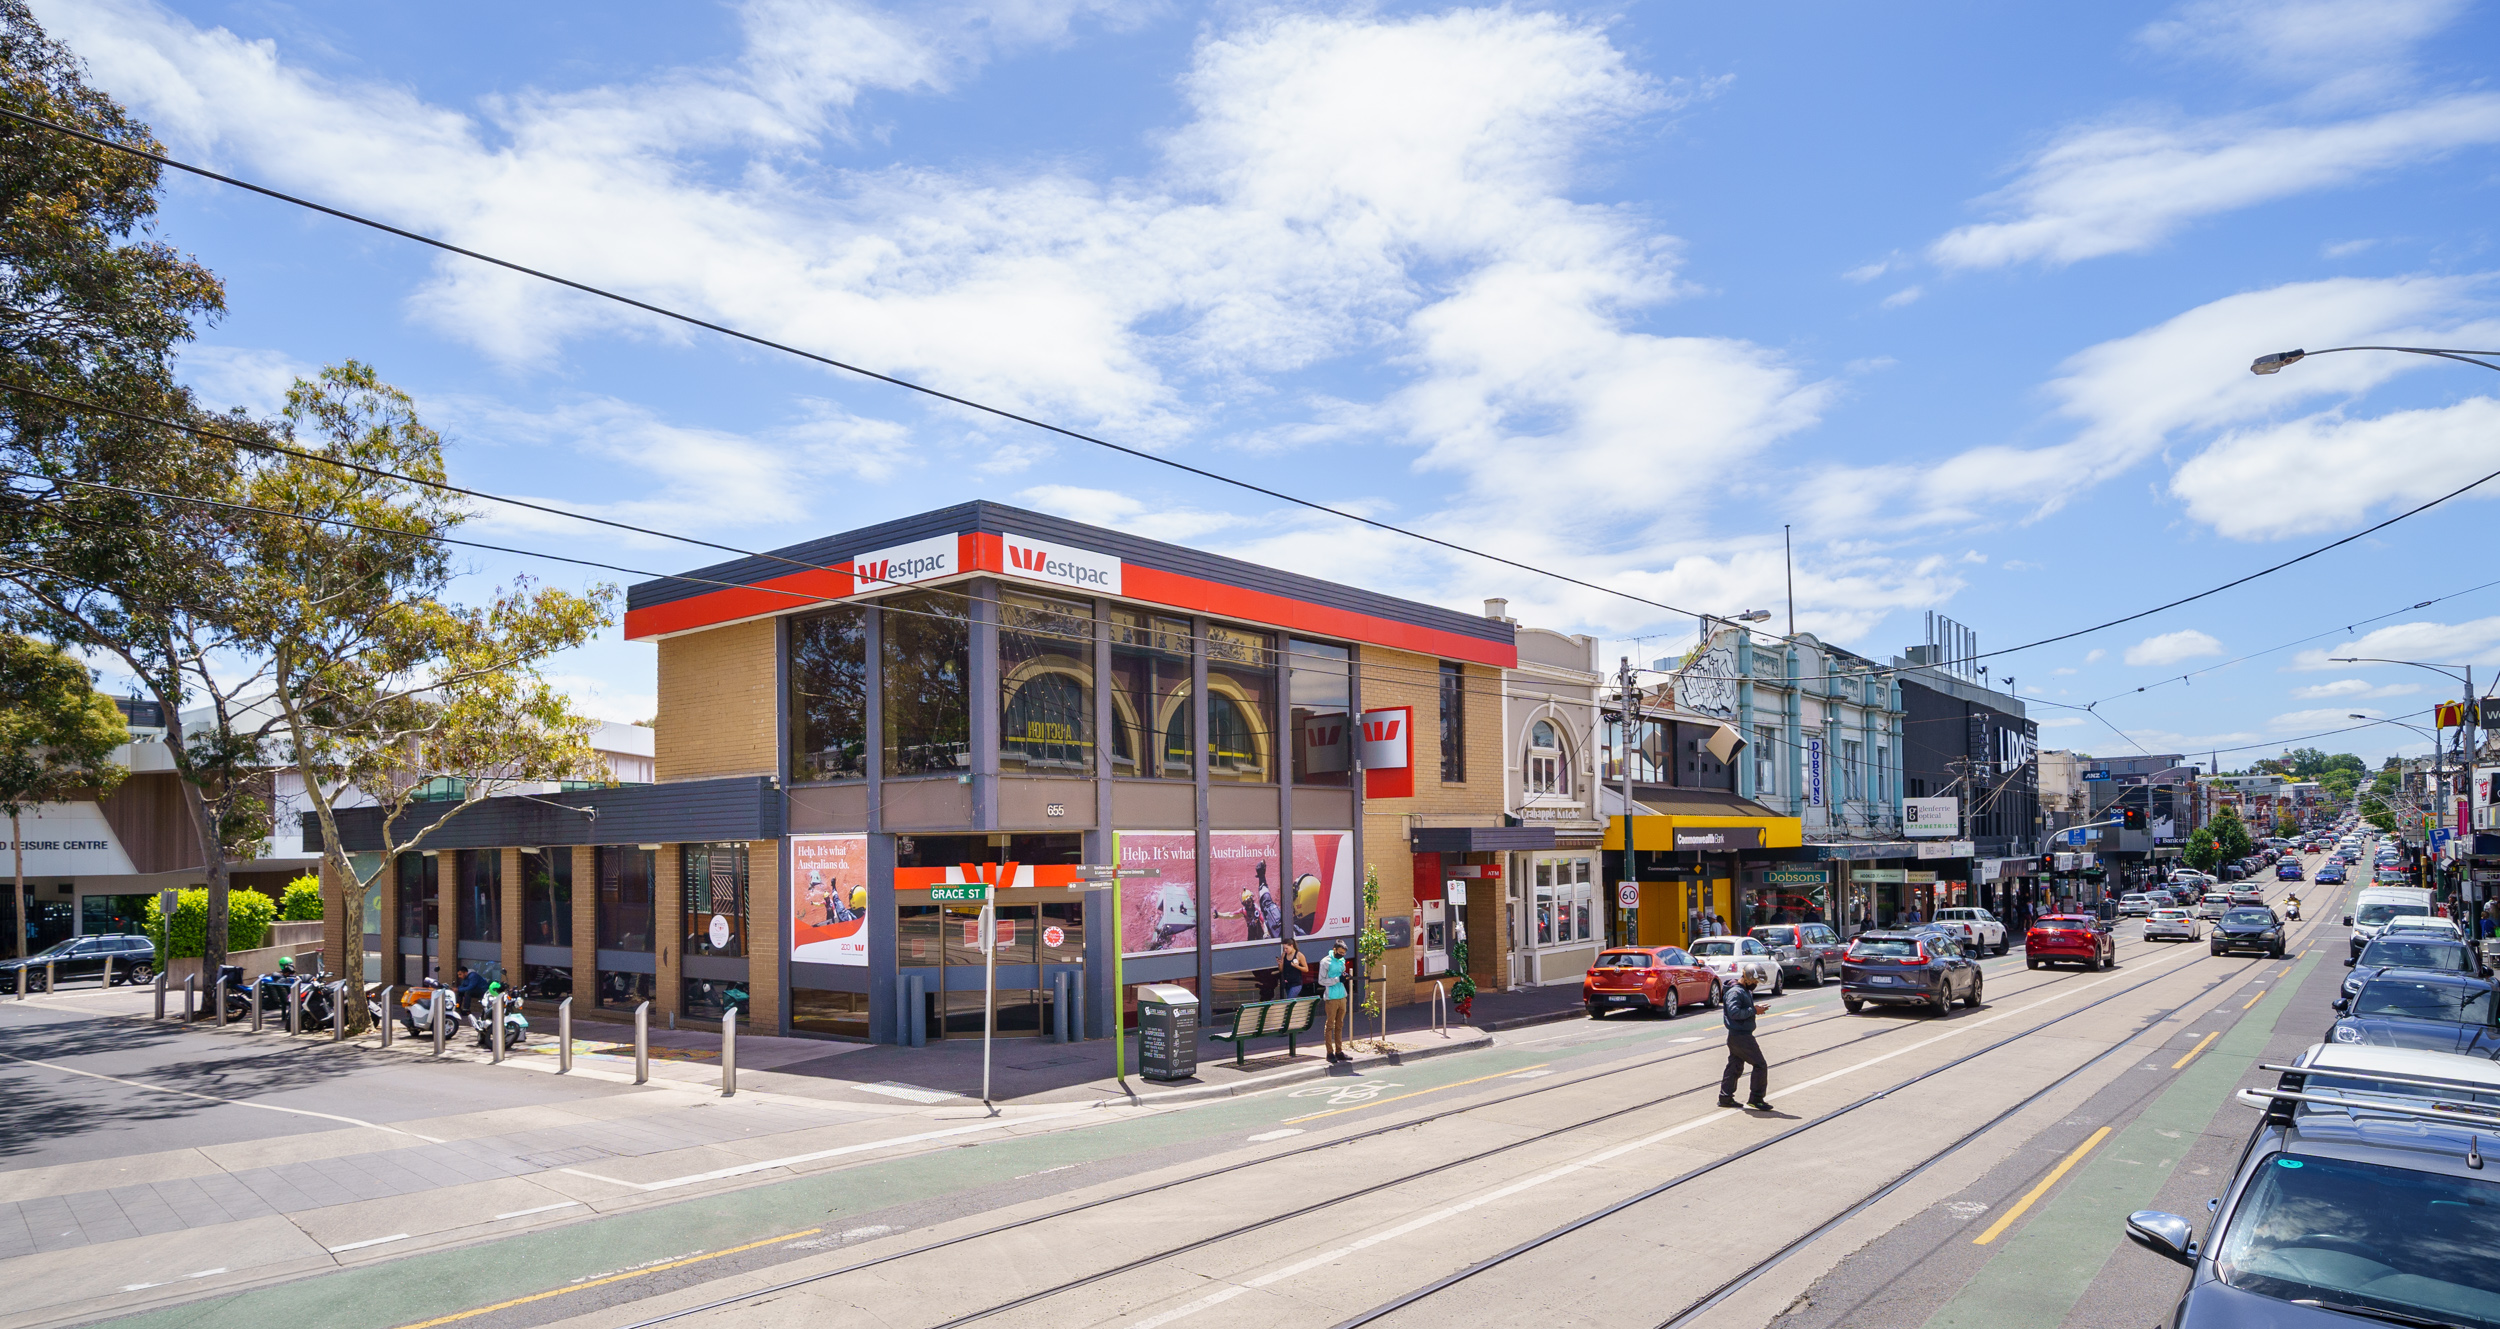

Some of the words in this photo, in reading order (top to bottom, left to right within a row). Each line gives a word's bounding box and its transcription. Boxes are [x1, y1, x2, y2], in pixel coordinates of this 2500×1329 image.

[858, 553, 945, 585] Westpac
[1008, 545, 1108, 586] Westpac
[1999, 726, 2027, 774] LIDO
[1811, 741, 1821, 805] DOBSONS
[1047, 804, 1065, 816] 655
[1521, 807, 1556, 820] Crabapple
[1919, 805, 1951, 813] glenferrie
[1919, 812, 1942, 820] optical
[2434, 830, 2445, 840] P
[11, 841, 60, 850] LEISURE
[63, 840, 108, 850] CENTRE
[798, 846, 816, 859] Help.
[817, 845, 828, 856] It's
[829, 846, 847, 856] what
[1122, 846, 1151, 863] Help.
[1153, 846, 1169, 860] It's
[1172, 846, 1196, 860] what
[1210, 845, 1263, 859] Australians
[1264, 845, 1277, 857] do.
[798, 860, 838, 870] Australians
[838, 859, 850, 869] do.
[1769, 872, 1821, 882] Dobsons
[931, 888, 965, 899] GRACE
[968, 888, 981, 899] ST
[1622, 890, 1636, 900] 60
